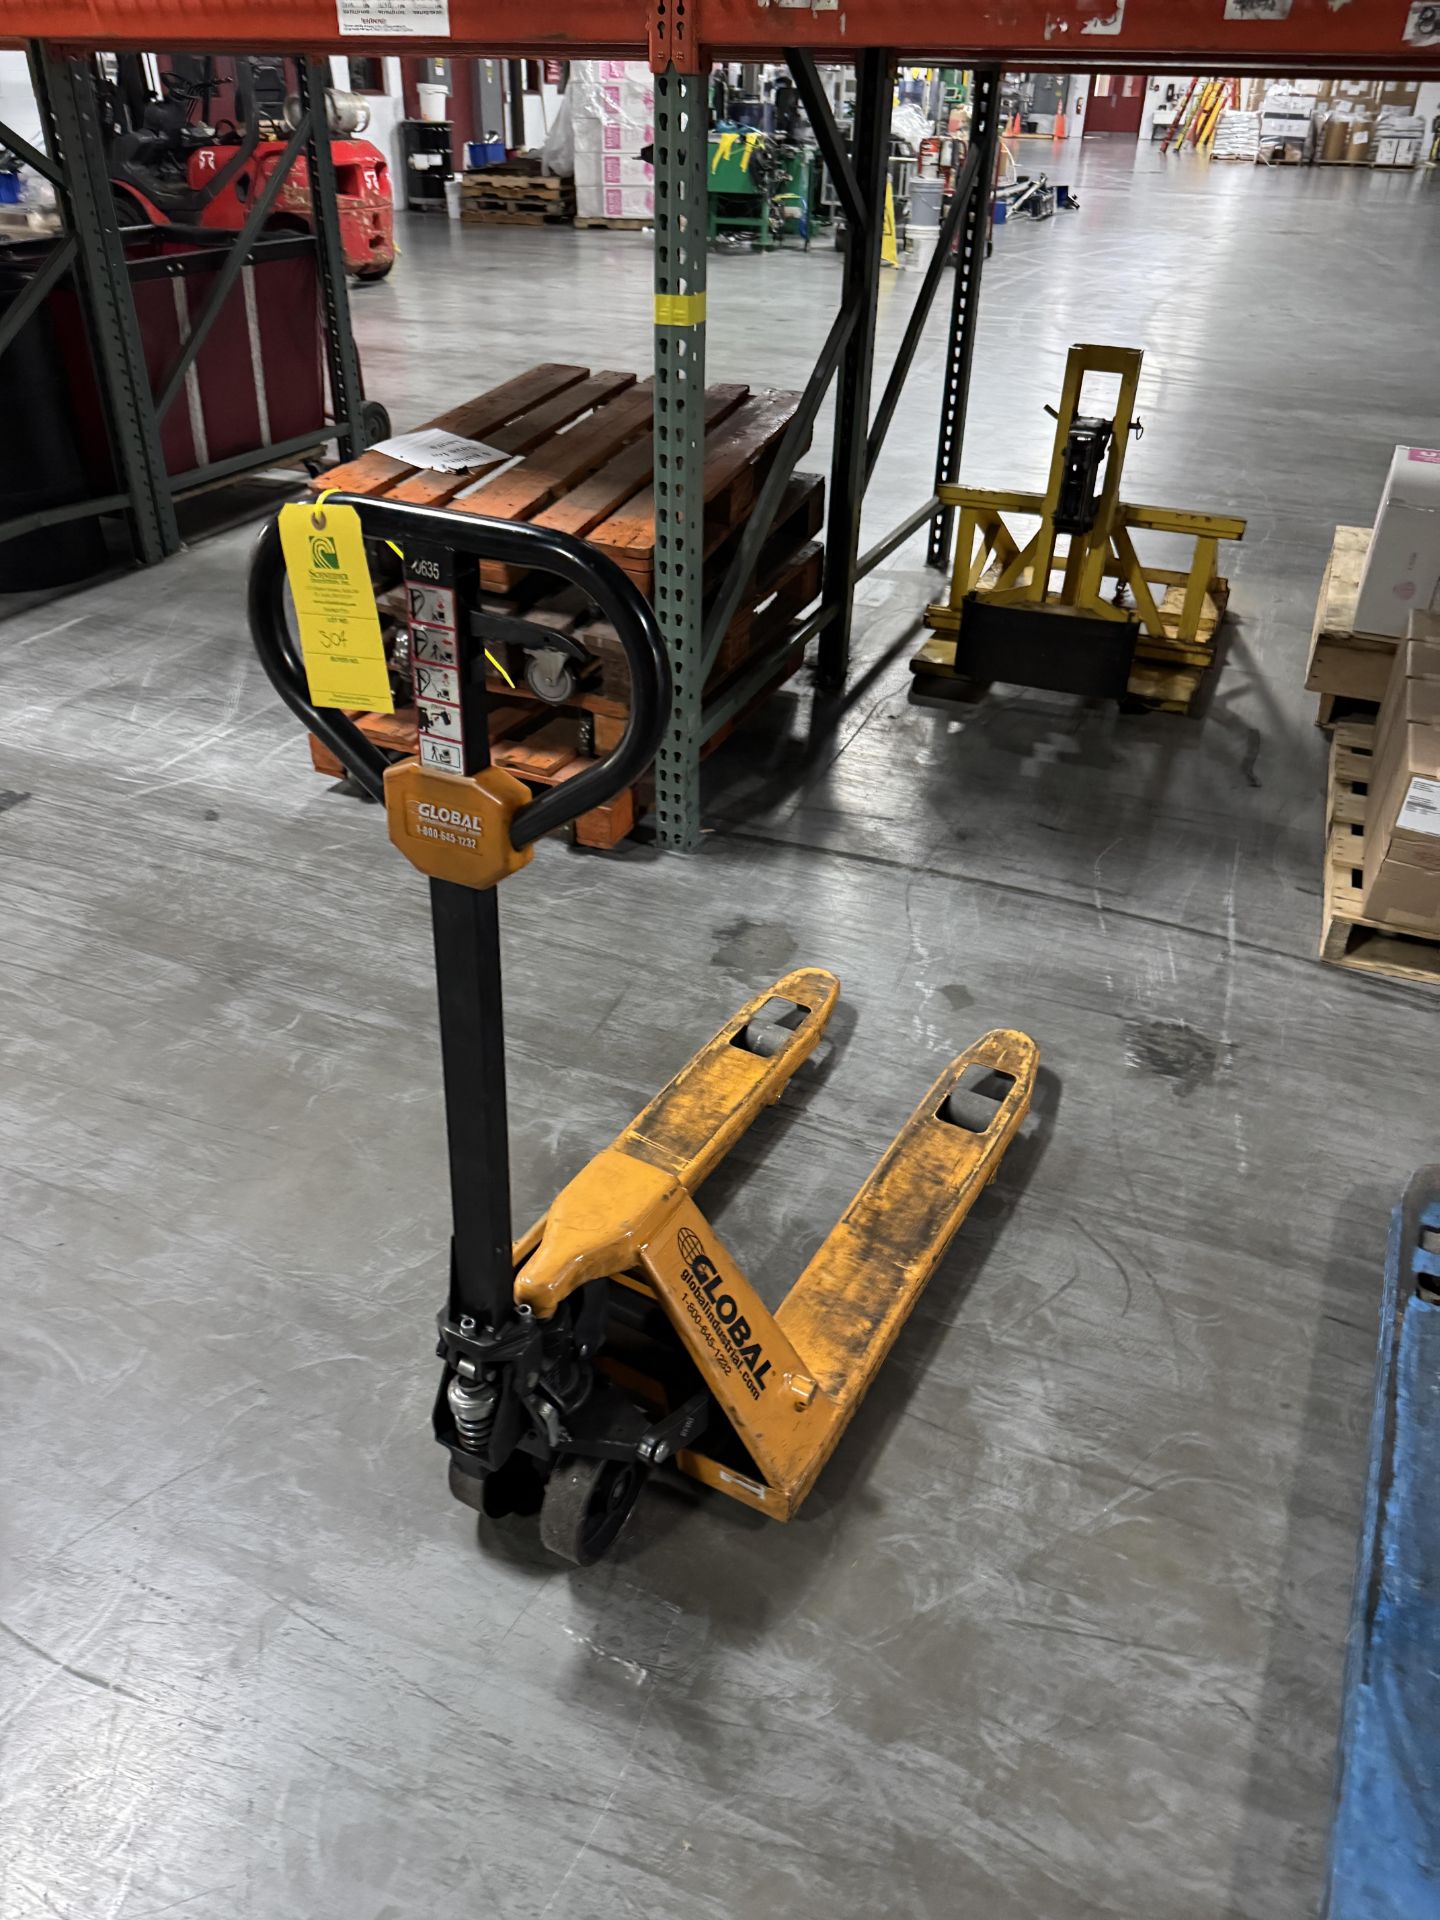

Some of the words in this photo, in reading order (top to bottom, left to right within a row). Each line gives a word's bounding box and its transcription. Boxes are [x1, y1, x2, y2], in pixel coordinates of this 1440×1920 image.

[417, 803, 482, 831] GLOBAL
[680, 1268, 760, 1401] globalindustrial.com
[681, 1292, 732, 1377] 1-800-645-1232
[690, 1254, 772, 1391] GLOBAL
